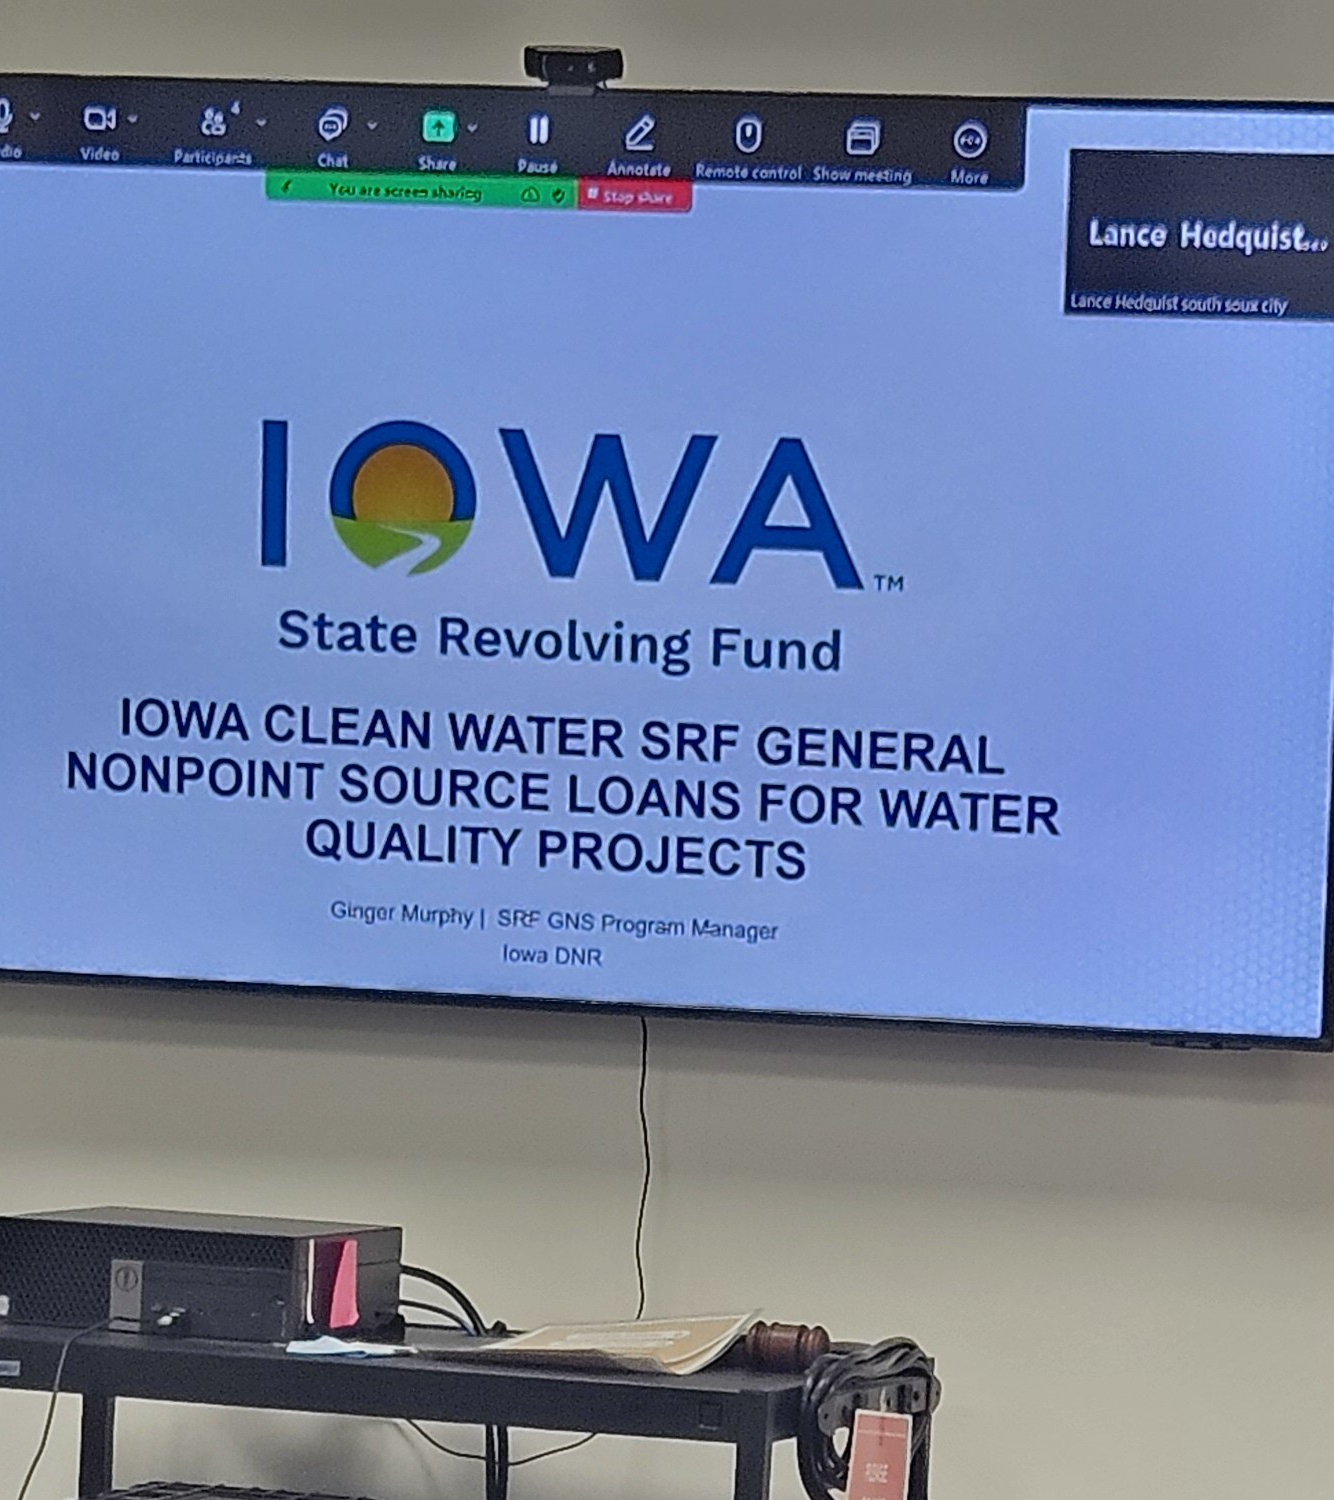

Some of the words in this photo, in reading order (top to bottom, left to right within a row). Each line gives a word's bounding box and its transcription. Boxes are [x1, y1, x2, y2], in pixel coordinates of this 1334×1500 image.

[80, 147, 119, 161] Video
[174, 148, 253, 167] Participants
[318, 153, 348, 168] Chat
[419, 155, 457, 171] Share
[518, 159, 557, 173] Pause
[608, 160, 670, 176] Annotate
[696, 163, 748, 178] Remote
[752, 165, 801, 179] control
[813, 166, 850, 180] Show
[853, 167, 912, 185] meeting
[951, 169, 988, 184] More
[330, 183, 355, 195] You
[604, 191, 634, 205] Stop
[638, 192, 672, 203] share
[1090, 220, 1167, 247] Lance
[1071, 294, 1112, 308] Lance
[1115, 294, 1178, 311] Hedquist
[1181, 296, 1222, 311] south
[1262, 298, 1288, 316] city
[262, 420, 864, 589] IOWA
[874, 575, 903, 591] TM
[279, 610, 416, 653] State
[440, 617, 691, 676] Revolving
[713, 628, 840, 671] Fund
[123, 698, 249, 741] IOWA
[265, 704, 430, 749] CLEAN
[449, 713, 623, 758] WATER
[642, 721, 739, 762] SRF
[758, 727, 1004, 774] GENERAL
[68, 751, 324, 800] NONPOINT
[340, 764, 549, 811] SOURCE
[570, 775, 739, 820] LOANS
[760, 784, 862, 825] FOR
[880, 789, 1059, 835] WATER
[307, 819, 521, 866] QUALITY
[540, 830, 805, 880] PROJECTS
[331, 901, 394, 924] Ginger
[402, 905, 473, 929] Murphy
[498, 909, 540, 927] SRF
[548, 912, 594, 931] GNS
[602, 914, 684, 938] Program
[692, 919, 778, 943] Manager
[504, 944, 547, 963] Iowa
[556, 947, 601, 965] DNR
